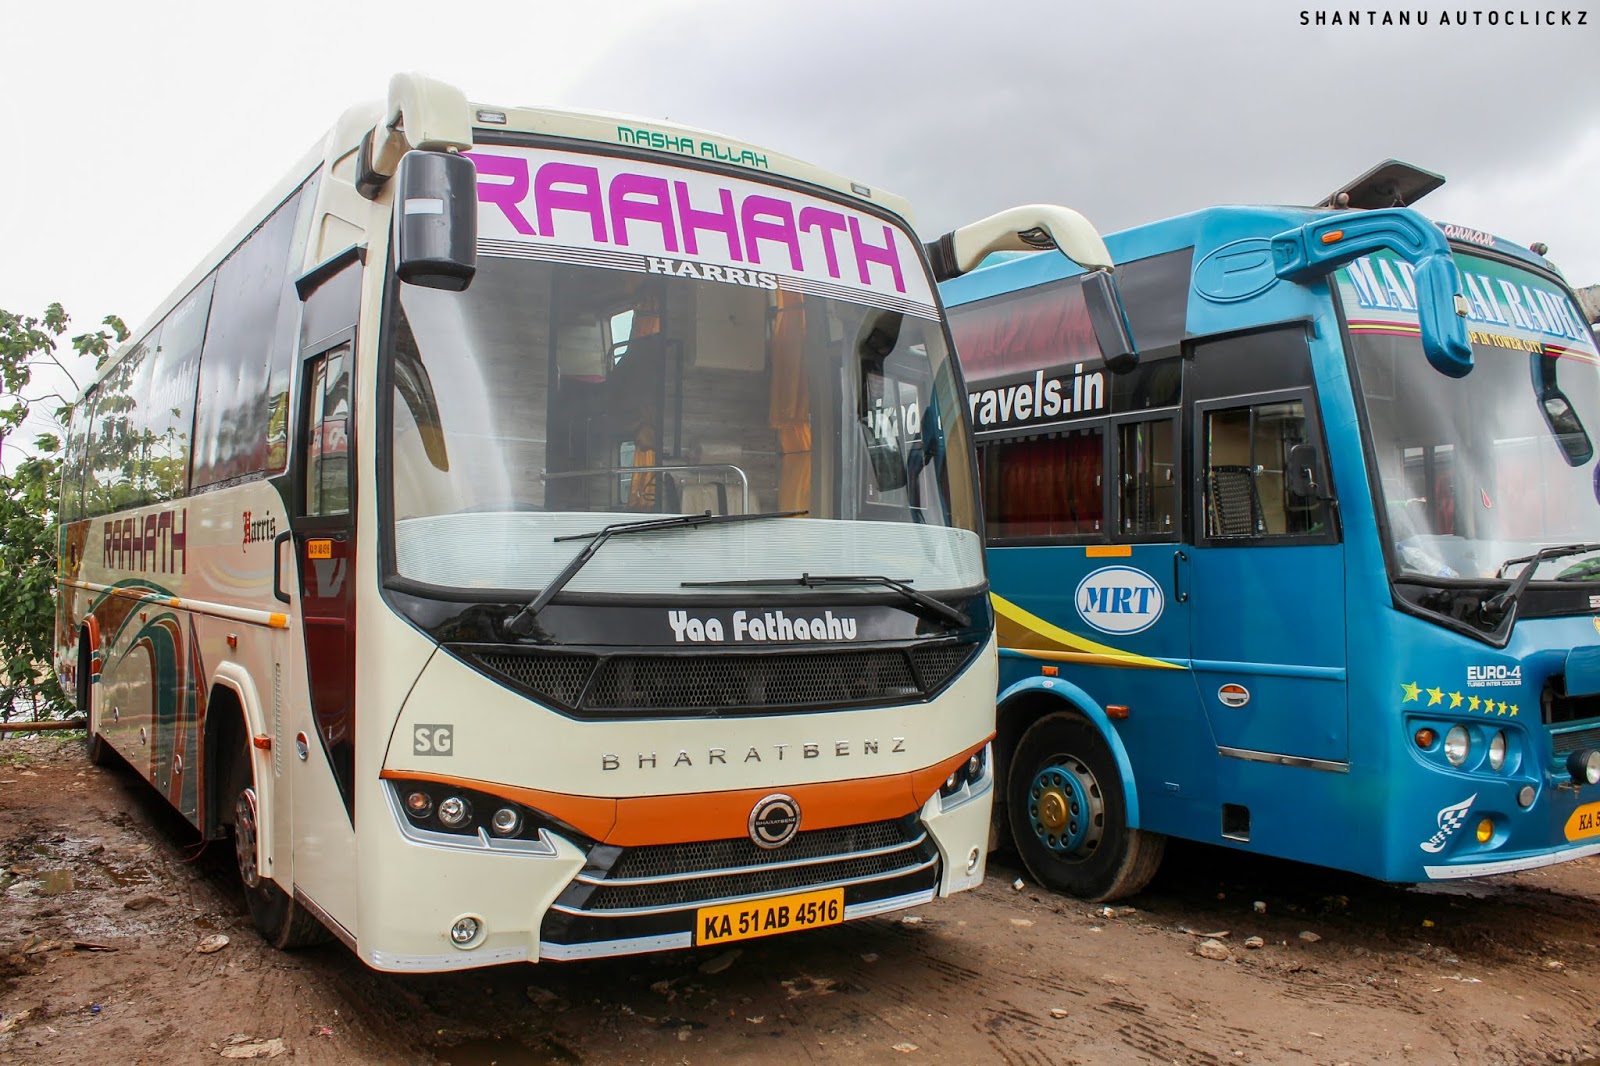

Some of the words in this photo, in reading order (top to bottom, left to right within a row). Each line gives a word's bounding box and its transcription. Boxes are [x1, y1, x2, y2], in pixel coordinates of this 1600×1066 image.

[617, 126, 695, 154] MASHA
[700, 141, 769, 169] ALLAH
[468, 152, 907, 294] RAAHATH
[646, 256, 778, 290] HARRIS
[103, 507, 188, 575] RAAHATH
[242, 510, 276, 554] Harris
[1082, 586, 1156, 615] MRT
[668, 610, 725, 642] Yaa
[732, 610, 858, 642] Fathaahu
[1466, 664, 1522, 680] EURO-4
[414, 727, 452, 753] SG
[601, 736, 906, 771] BHARATBENZ
[1578, 813, 1593, 831] KA
[704, 914, 733, 940] KA
[738, 909, 760, 934] 51
[763, 905, 790, 930] AB
[795, 898, 839, 925] 4516
